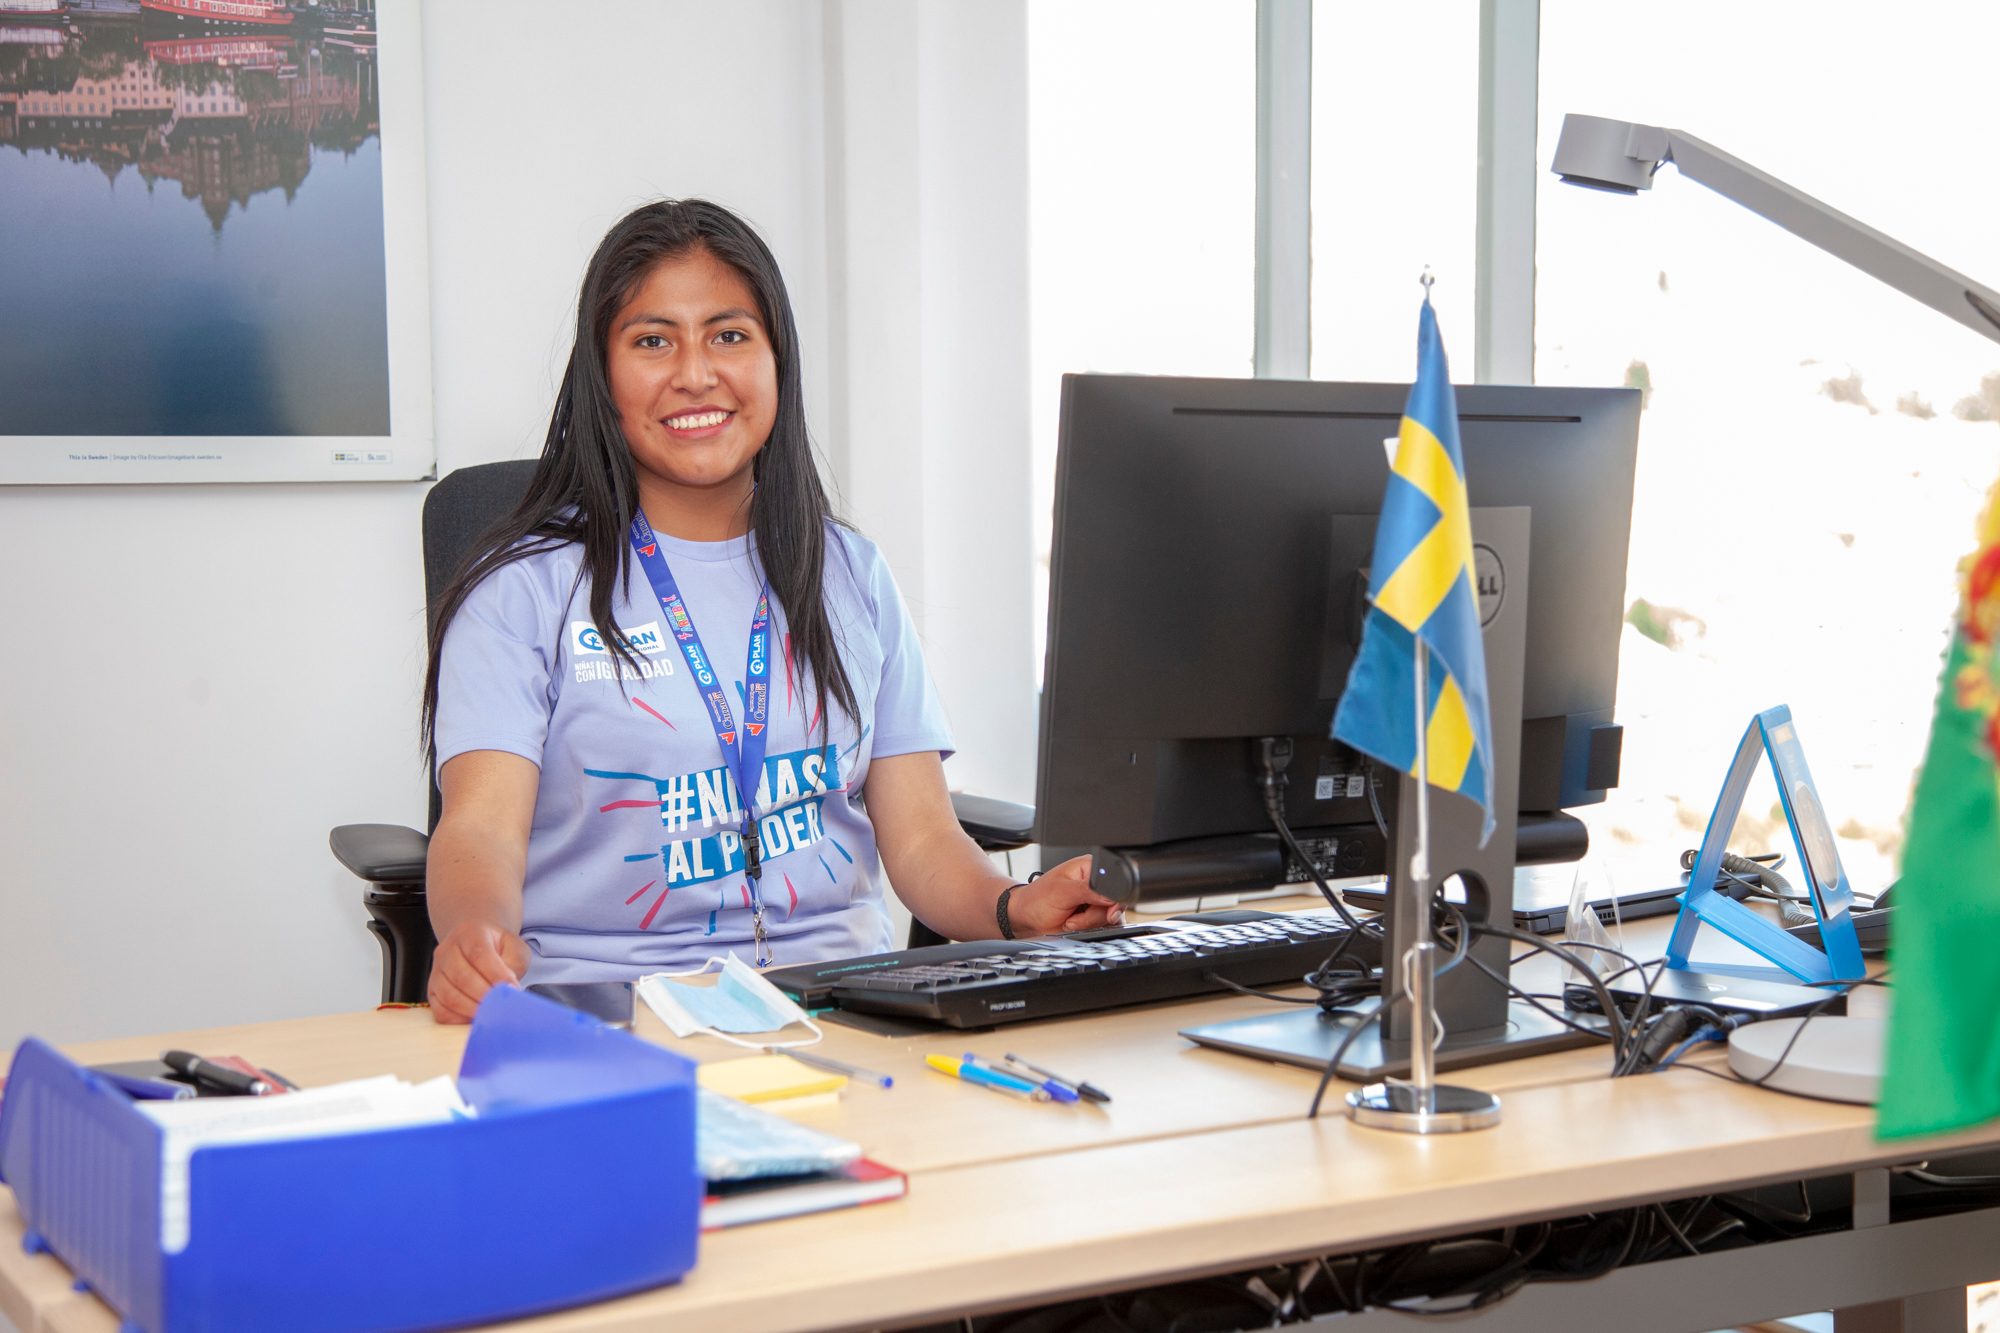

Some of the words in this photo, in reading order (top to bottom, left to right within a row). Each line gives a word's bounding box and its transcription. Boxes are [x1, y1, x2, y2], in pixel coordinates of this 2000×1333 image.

[687, 645, 702, 670] PLAN
[753, 634, 762, 659] PLAN
[575, 669, 596, 683] CON
[668, 837, 714, 883] AL
[720, 801, 823, 872] PDER
